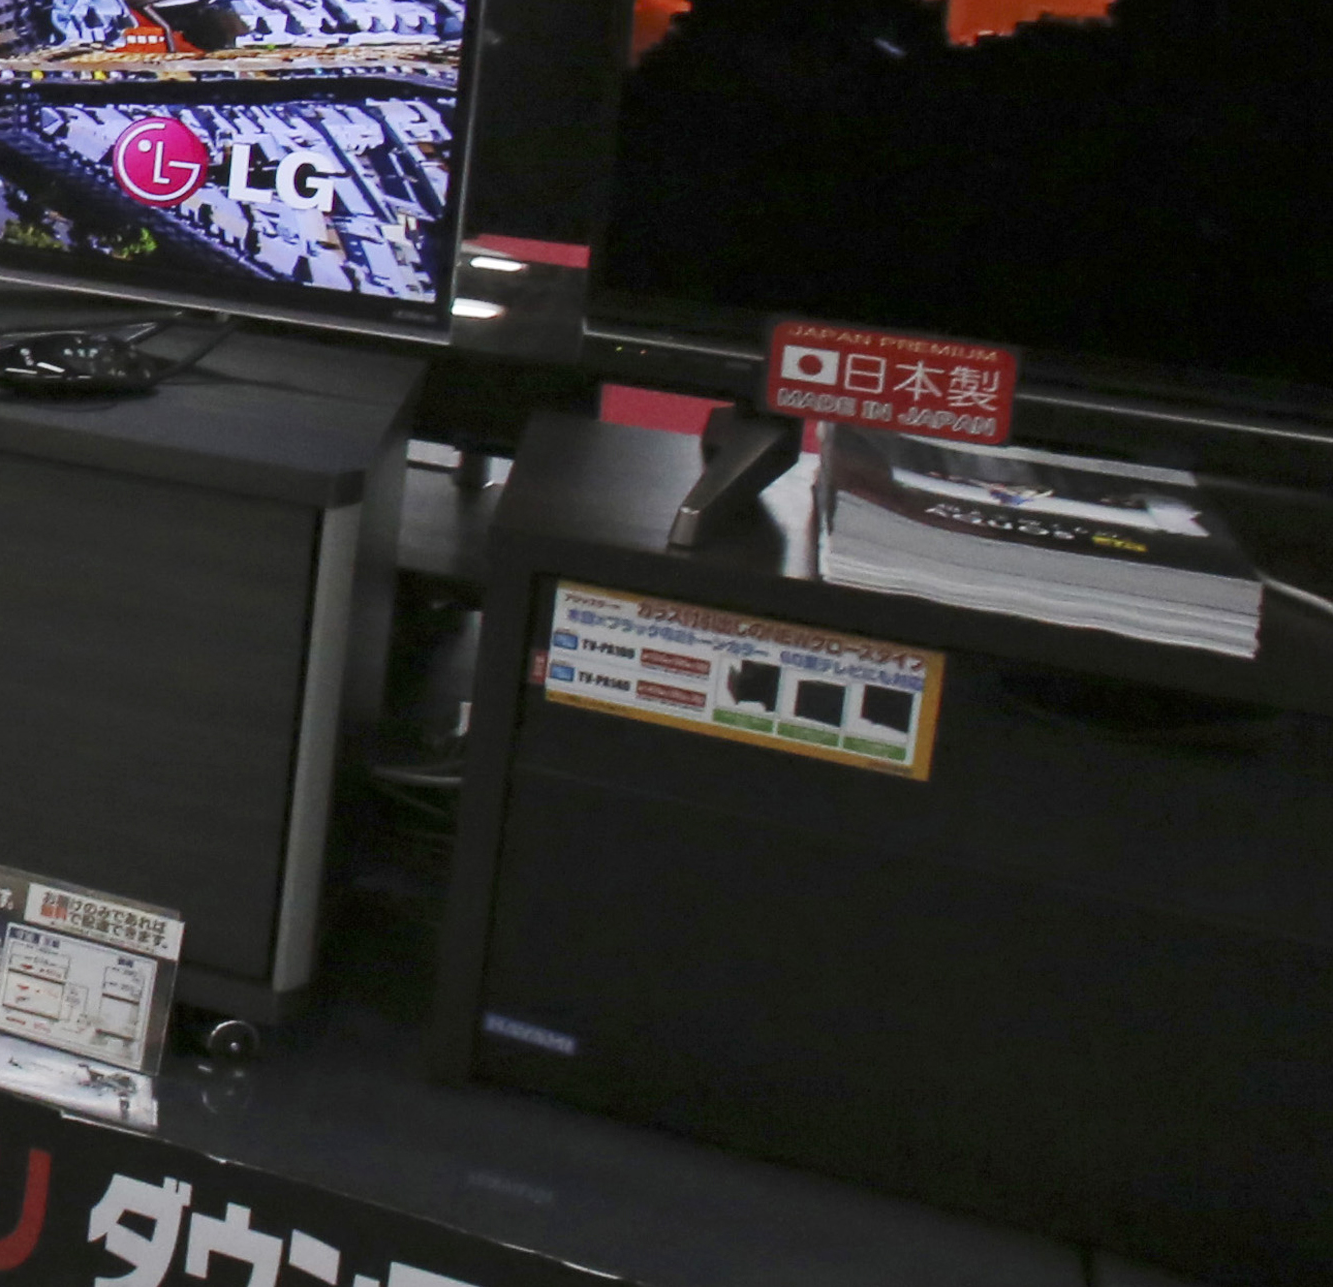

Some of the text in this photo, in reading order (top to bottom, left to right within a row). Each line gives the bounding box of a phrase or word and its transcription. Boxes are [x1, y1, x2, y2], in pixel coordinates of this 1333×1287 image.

[228, 143, 346, 212] LG
[844, 353, 1001, 411] 日本製
